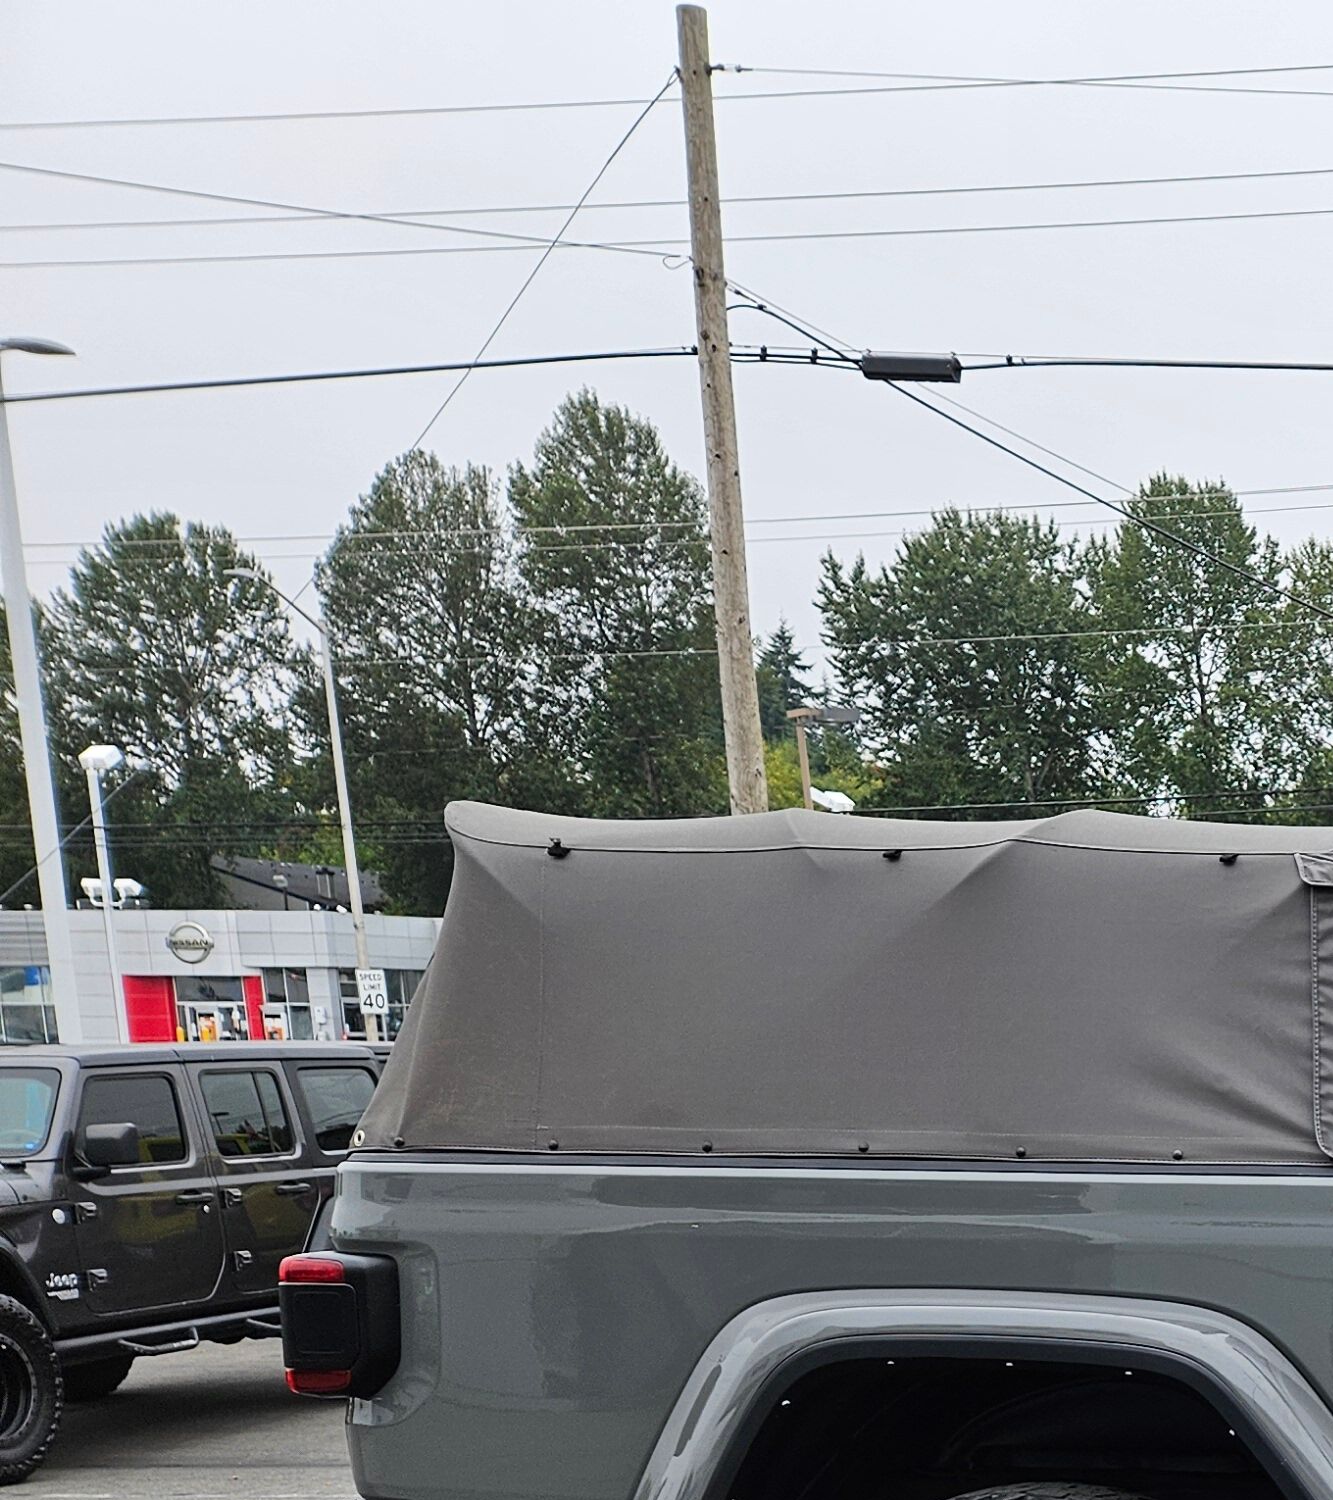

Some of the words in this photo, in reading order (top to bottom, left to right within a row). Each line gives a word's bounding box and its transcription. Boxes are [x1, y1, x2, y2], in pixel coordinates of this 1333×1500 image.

[168, 938, 210, 948] NISSAN
[359, 972, 383, 982] SPEED
[362, 983, 382, 992] LIMIT
[363, 992, 386, 1010] 40
[45, 1272, 78, 1288] Jeep
